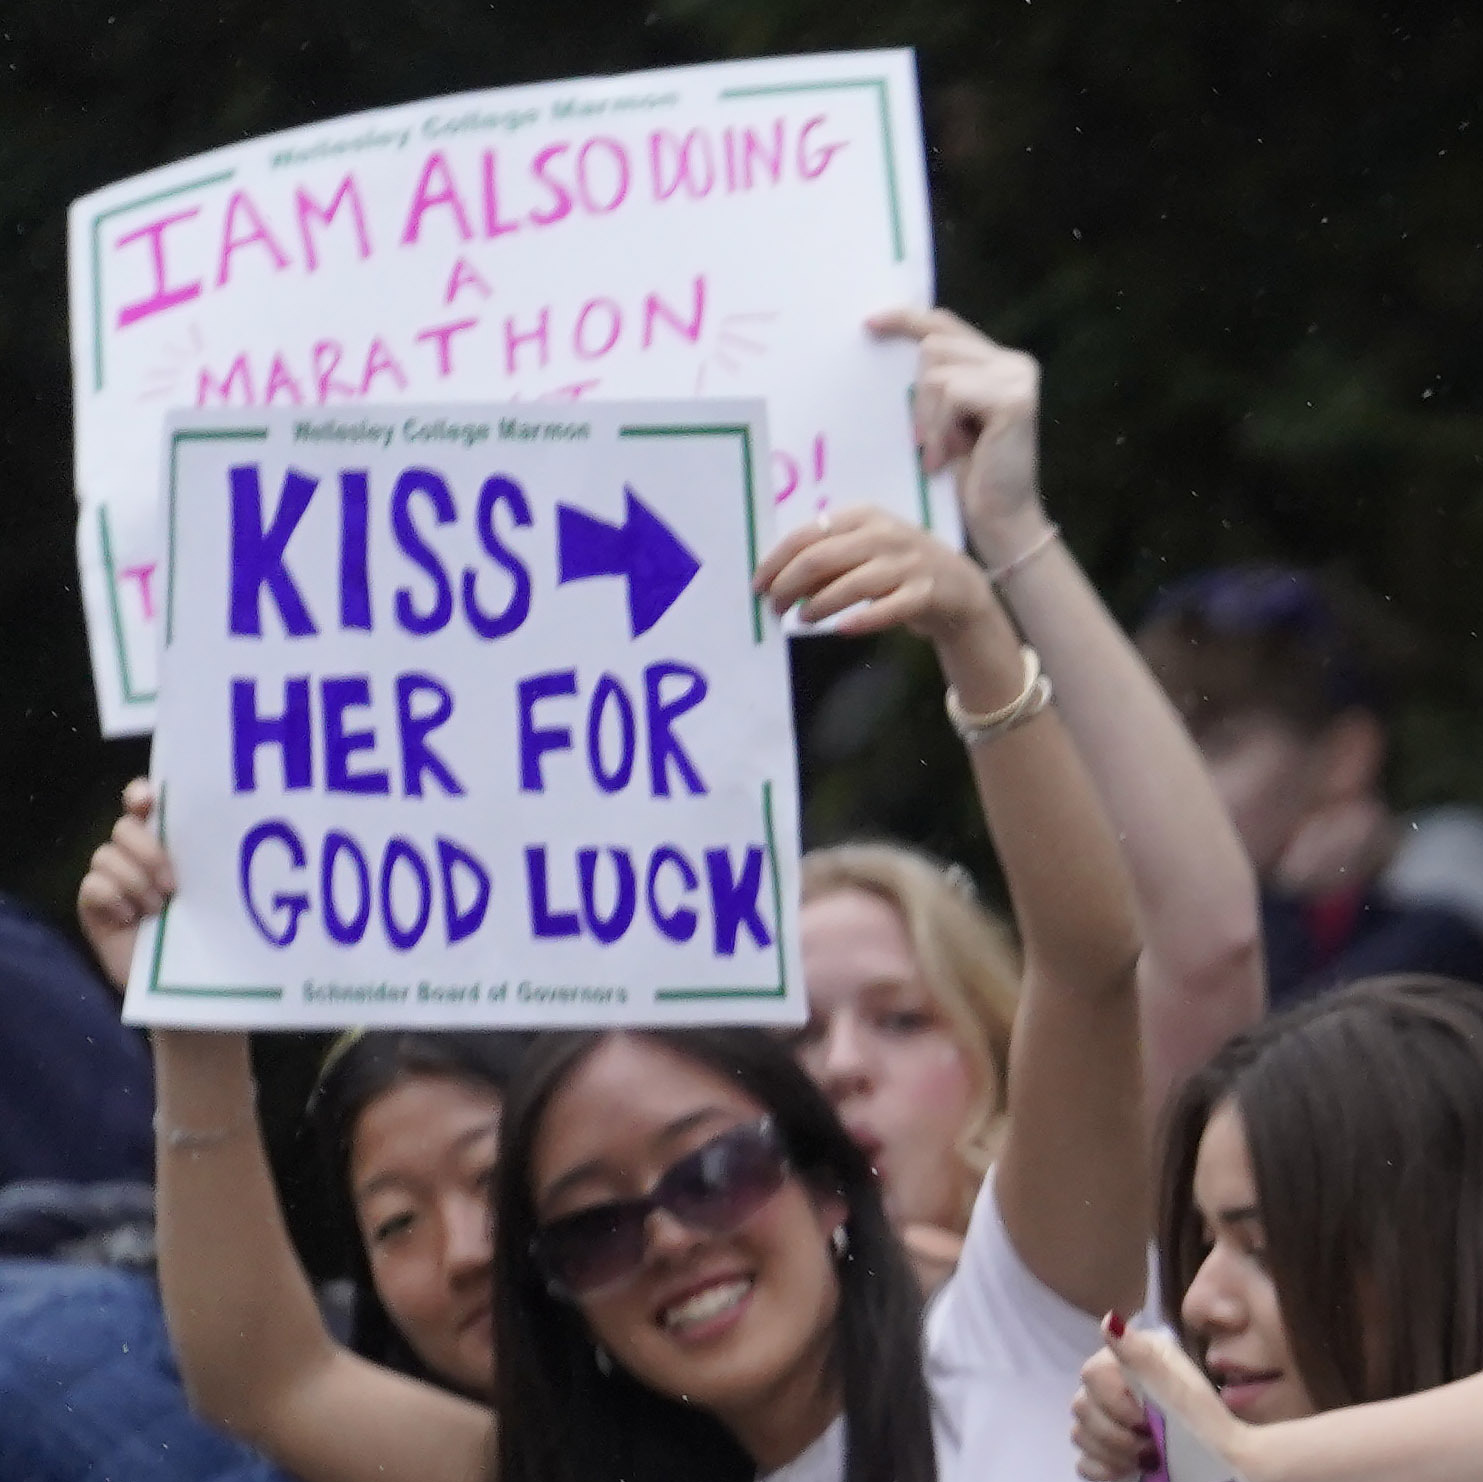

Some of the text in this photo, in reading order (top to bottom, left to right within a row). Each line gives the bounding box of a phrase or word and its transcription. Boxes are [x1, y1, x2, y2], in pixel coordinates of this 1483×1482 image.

[116, 113, 850, 330] I AM ALSO DOING
[445, 257, 493, 306] A
[198, 272, 706, 405] MARATHON
[228, 463, 533, 639] KISS
[230, 659, 710, 798] HER FOR
[239, 817, 772, 956] GOOD LUCK
